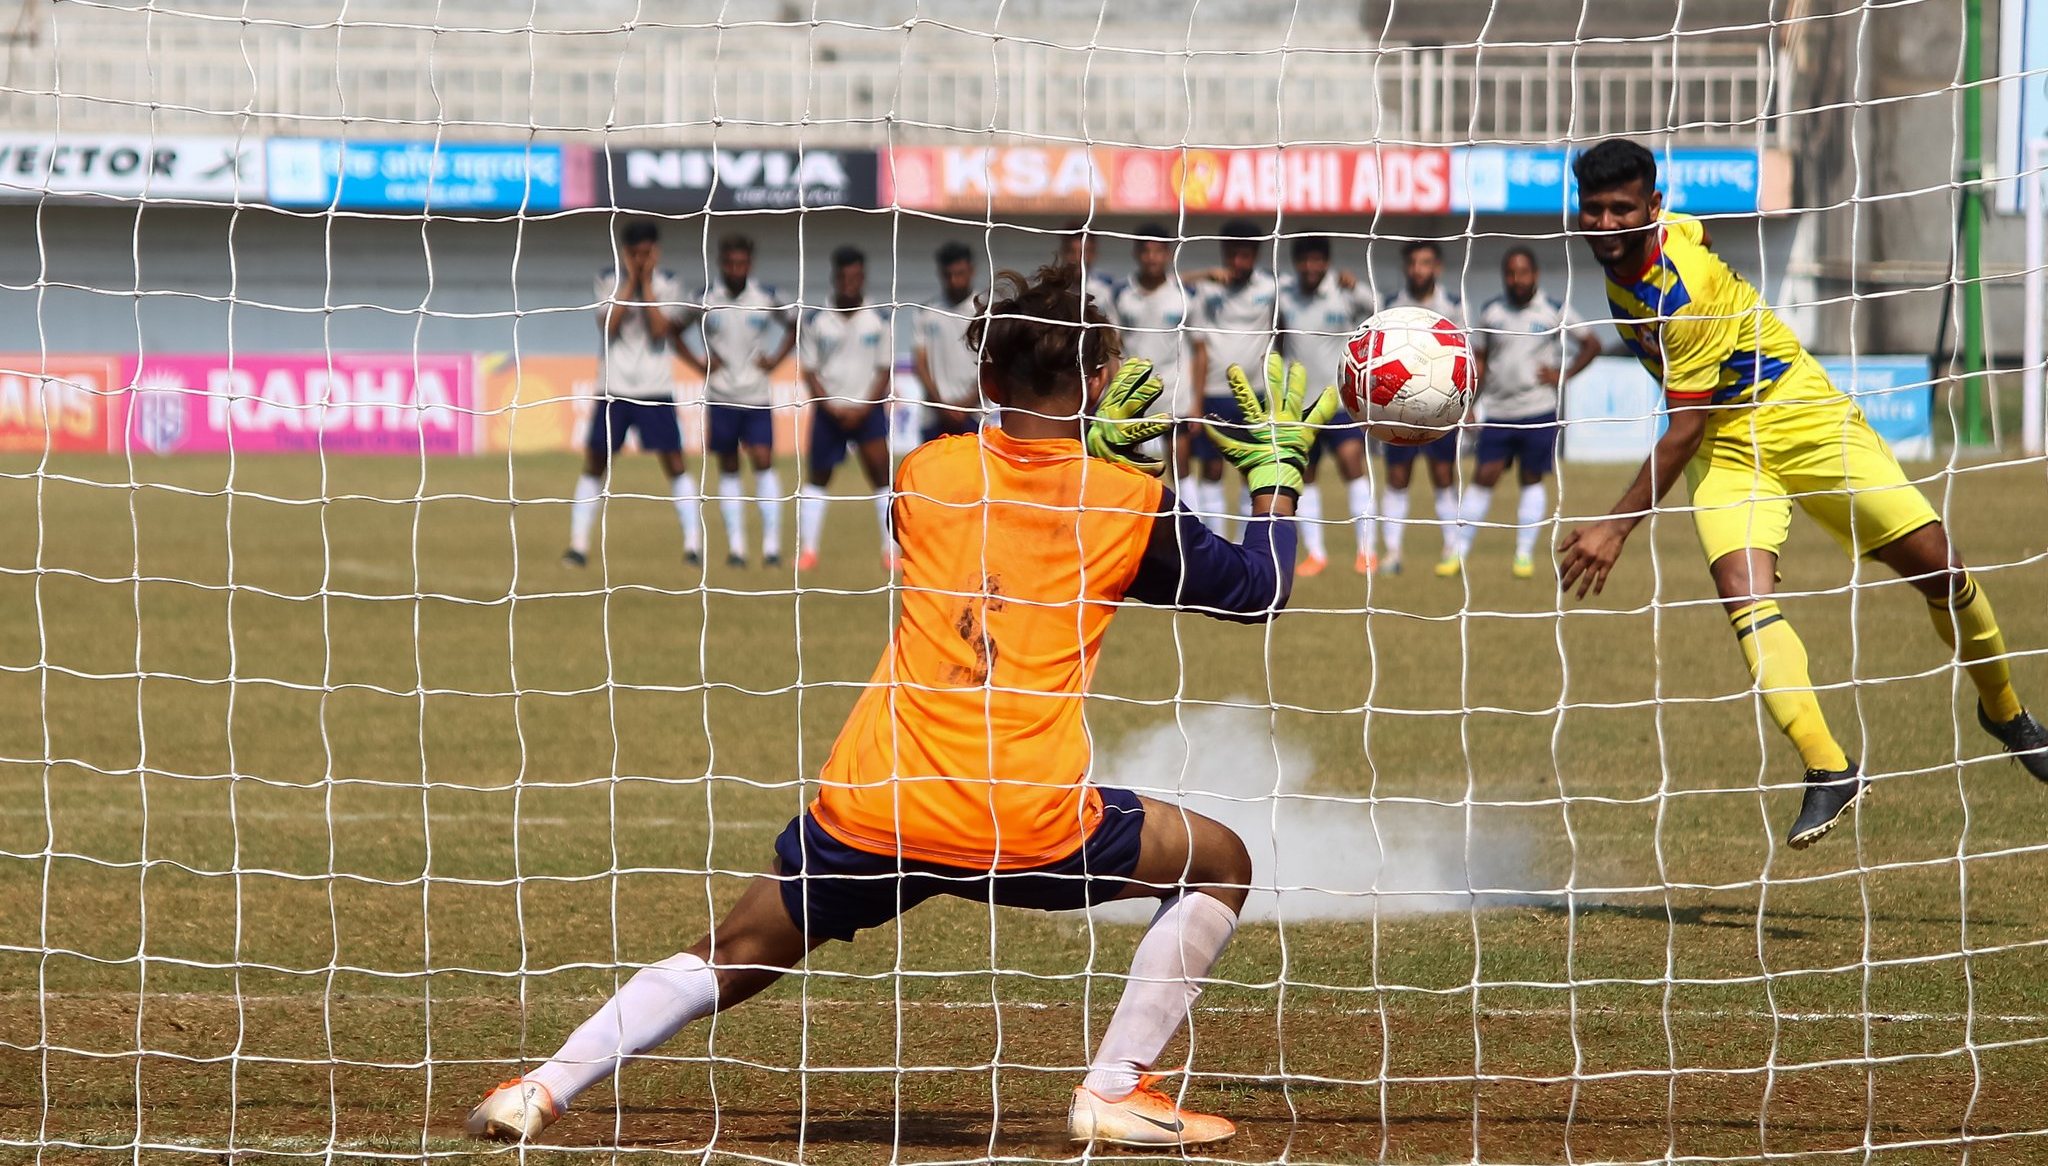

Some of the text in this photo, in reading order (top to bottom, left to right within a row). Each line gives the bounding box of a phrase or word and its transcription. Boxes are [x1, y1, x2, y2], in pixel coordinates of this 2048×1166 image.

[626, 150, 849, 189] NIVIA
[944, 146, 1108, 196] KSA
[1222, 150, 1444, 211] ABHI ADS
[206, 368, 455, 432] RADHA
